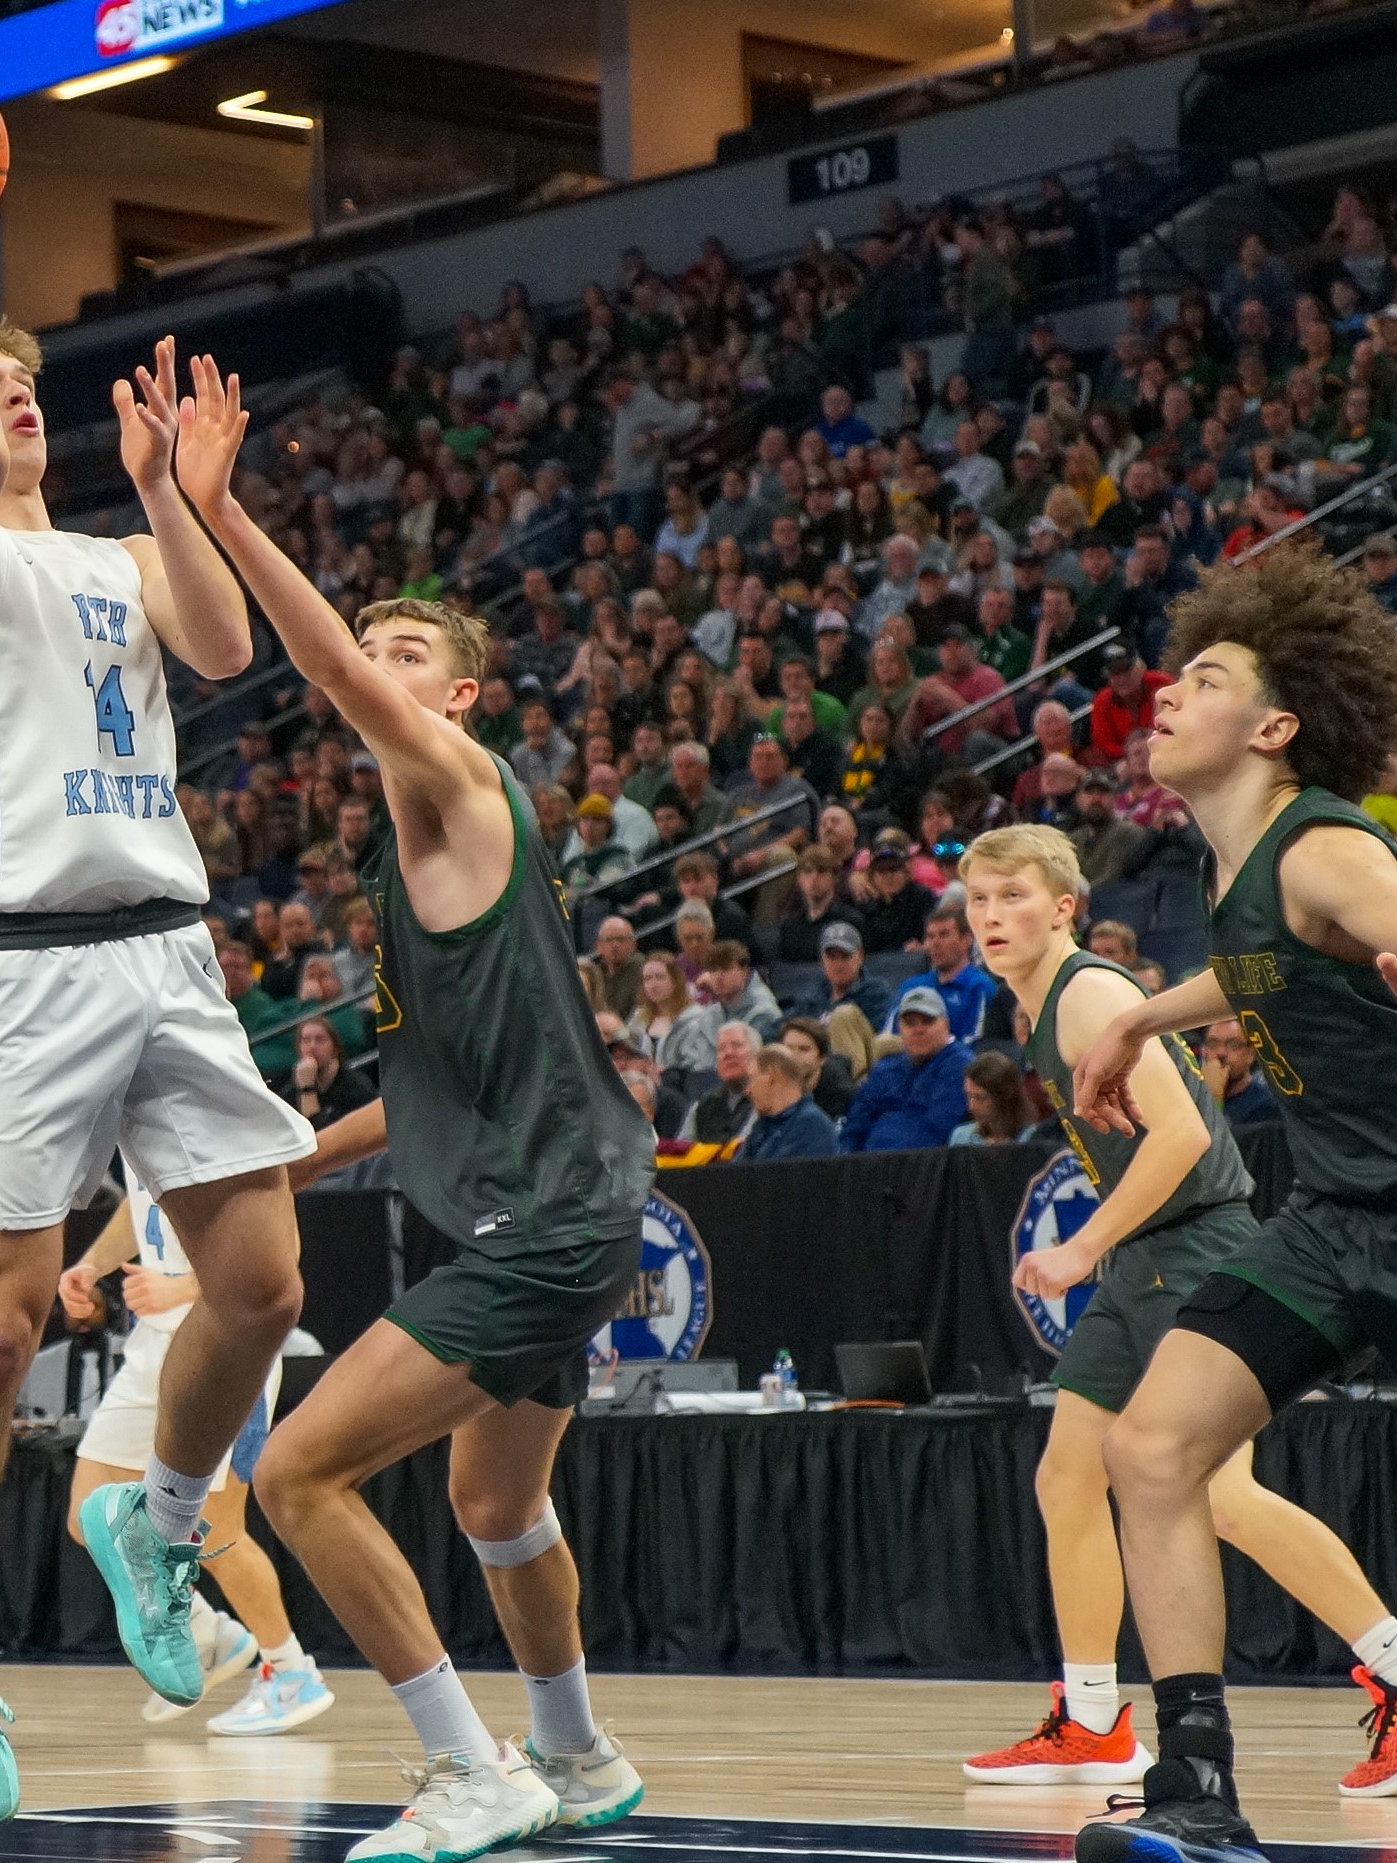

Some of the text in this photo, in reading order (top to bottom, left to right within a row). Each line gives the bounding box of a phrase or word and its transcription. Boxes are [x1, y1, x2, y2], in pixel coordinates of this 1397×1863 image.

[815, 147, 870, 191] 109
[63, 768, 177, 820] KNHTS
[496, 1213, 512, 1224] XXL
